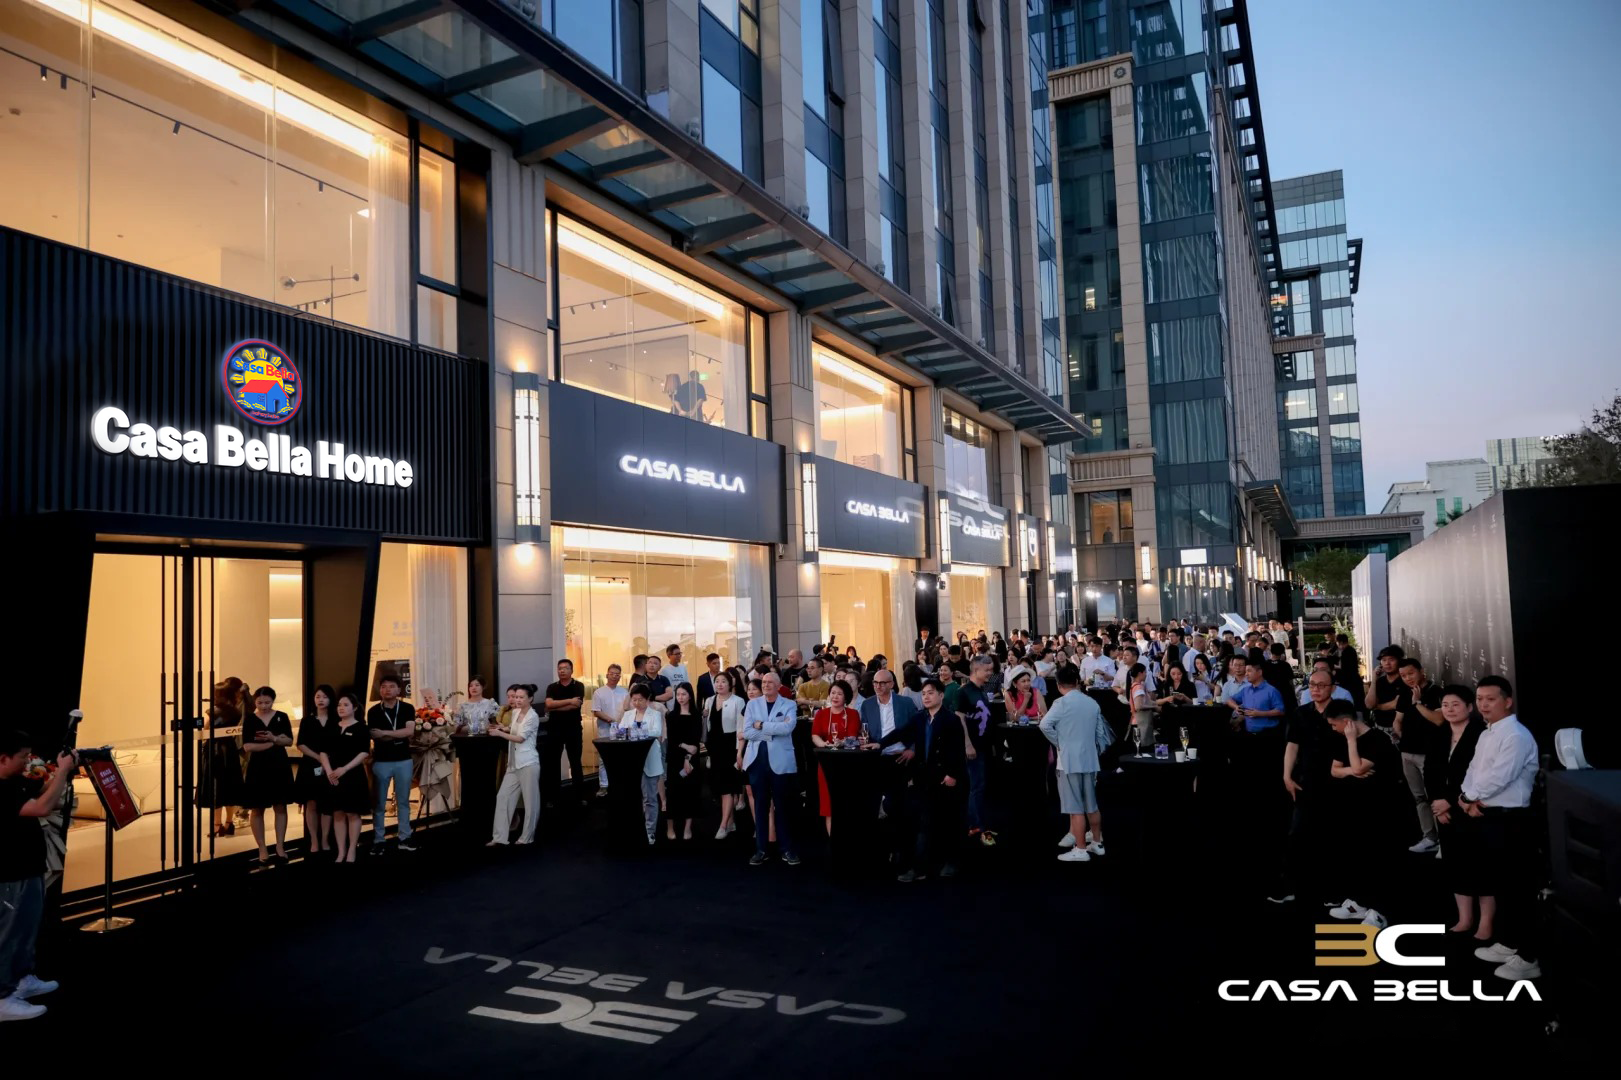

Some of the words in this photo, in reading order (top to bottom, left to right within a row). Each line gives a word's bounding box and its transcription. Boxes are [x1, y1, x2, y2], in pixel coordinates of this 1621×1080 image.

[230, 356, 264, 375] Casa
[266, 364, 295, 382] Bella
[91, 406, 208, 464] Casa
[214, 424, 312, 477] Bella
[316, 440, 414, 488] Home
[620, 454, 682, 482] CASA
[684, 466, 746, 494] BELLA
[846, 500, 877, 518] CASA
[878, 506, 910, 523] BELLA
